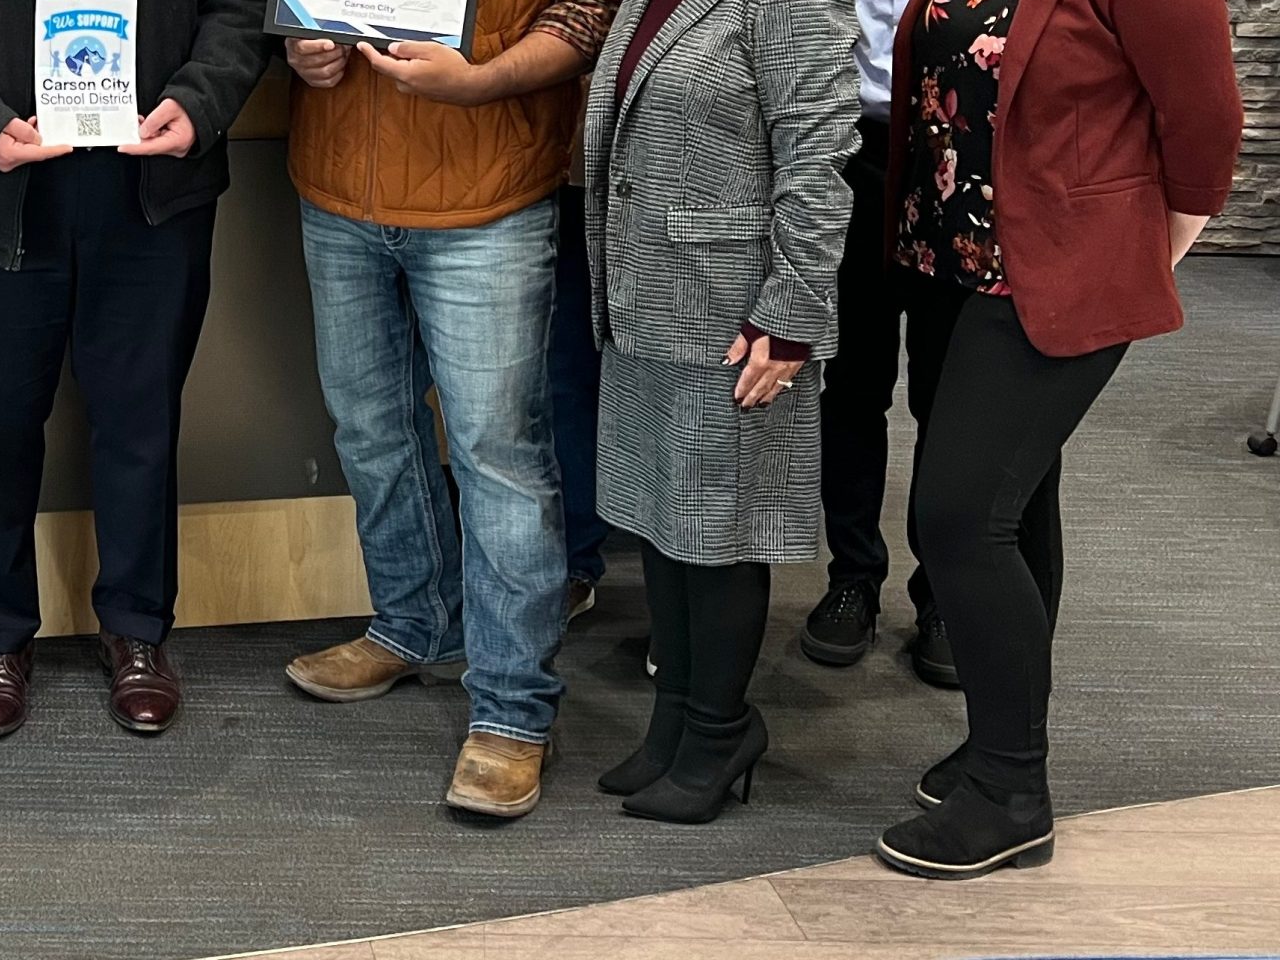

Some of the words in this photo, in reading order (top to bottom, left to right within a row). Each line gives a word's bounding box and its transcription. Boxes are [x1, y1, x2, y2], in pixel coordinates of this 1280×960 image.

[344, 0, 376, 10] Carson
[377, 3, 396, 14] City
[52, 14, 75, 29] We
[76, 13, 121, 29] SUPPORT
[42, 78, 97, 91] Carson
[101, 78, 130, 93] City
[40, 93, 85, 105] School
[89, 92, 133, 105] District
